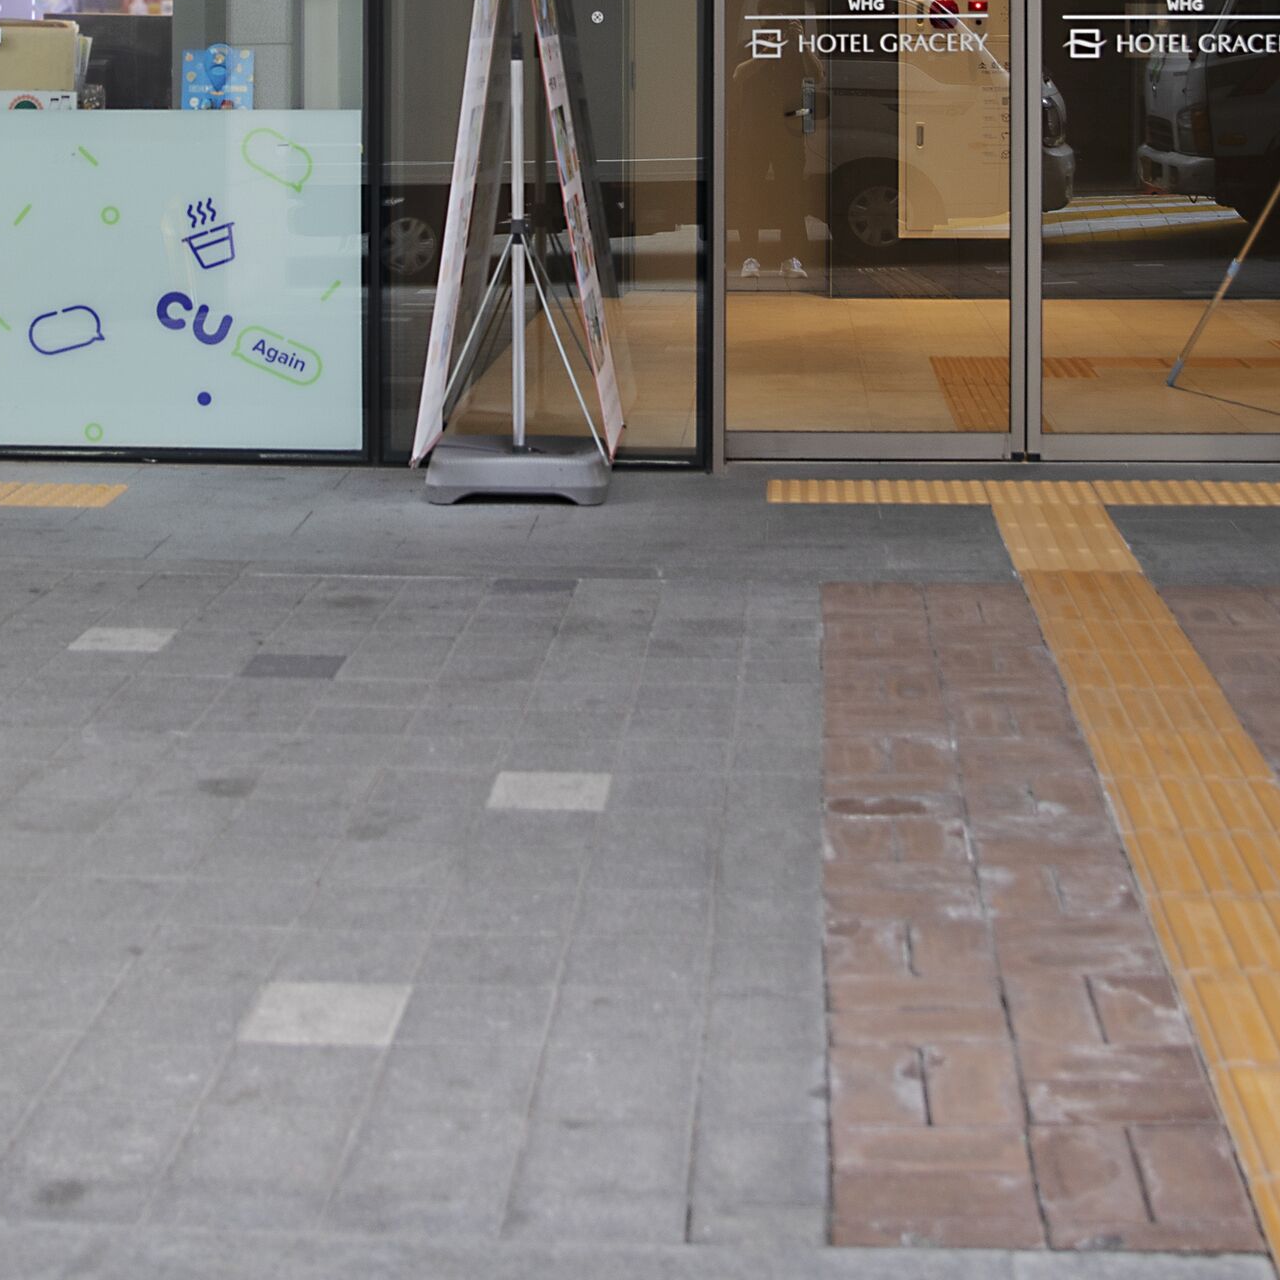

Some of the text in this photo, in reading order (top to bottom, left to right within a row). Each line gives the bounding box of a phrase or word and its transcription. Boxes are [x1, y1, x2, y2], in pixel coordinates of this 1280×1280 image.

[798, 32, 989, 54] HOTEL GRACERY
[1116, 33, 1193, 54] HOTEL
[156, 291, 234, 346] CU
[251, 337, 306, 373] Again
